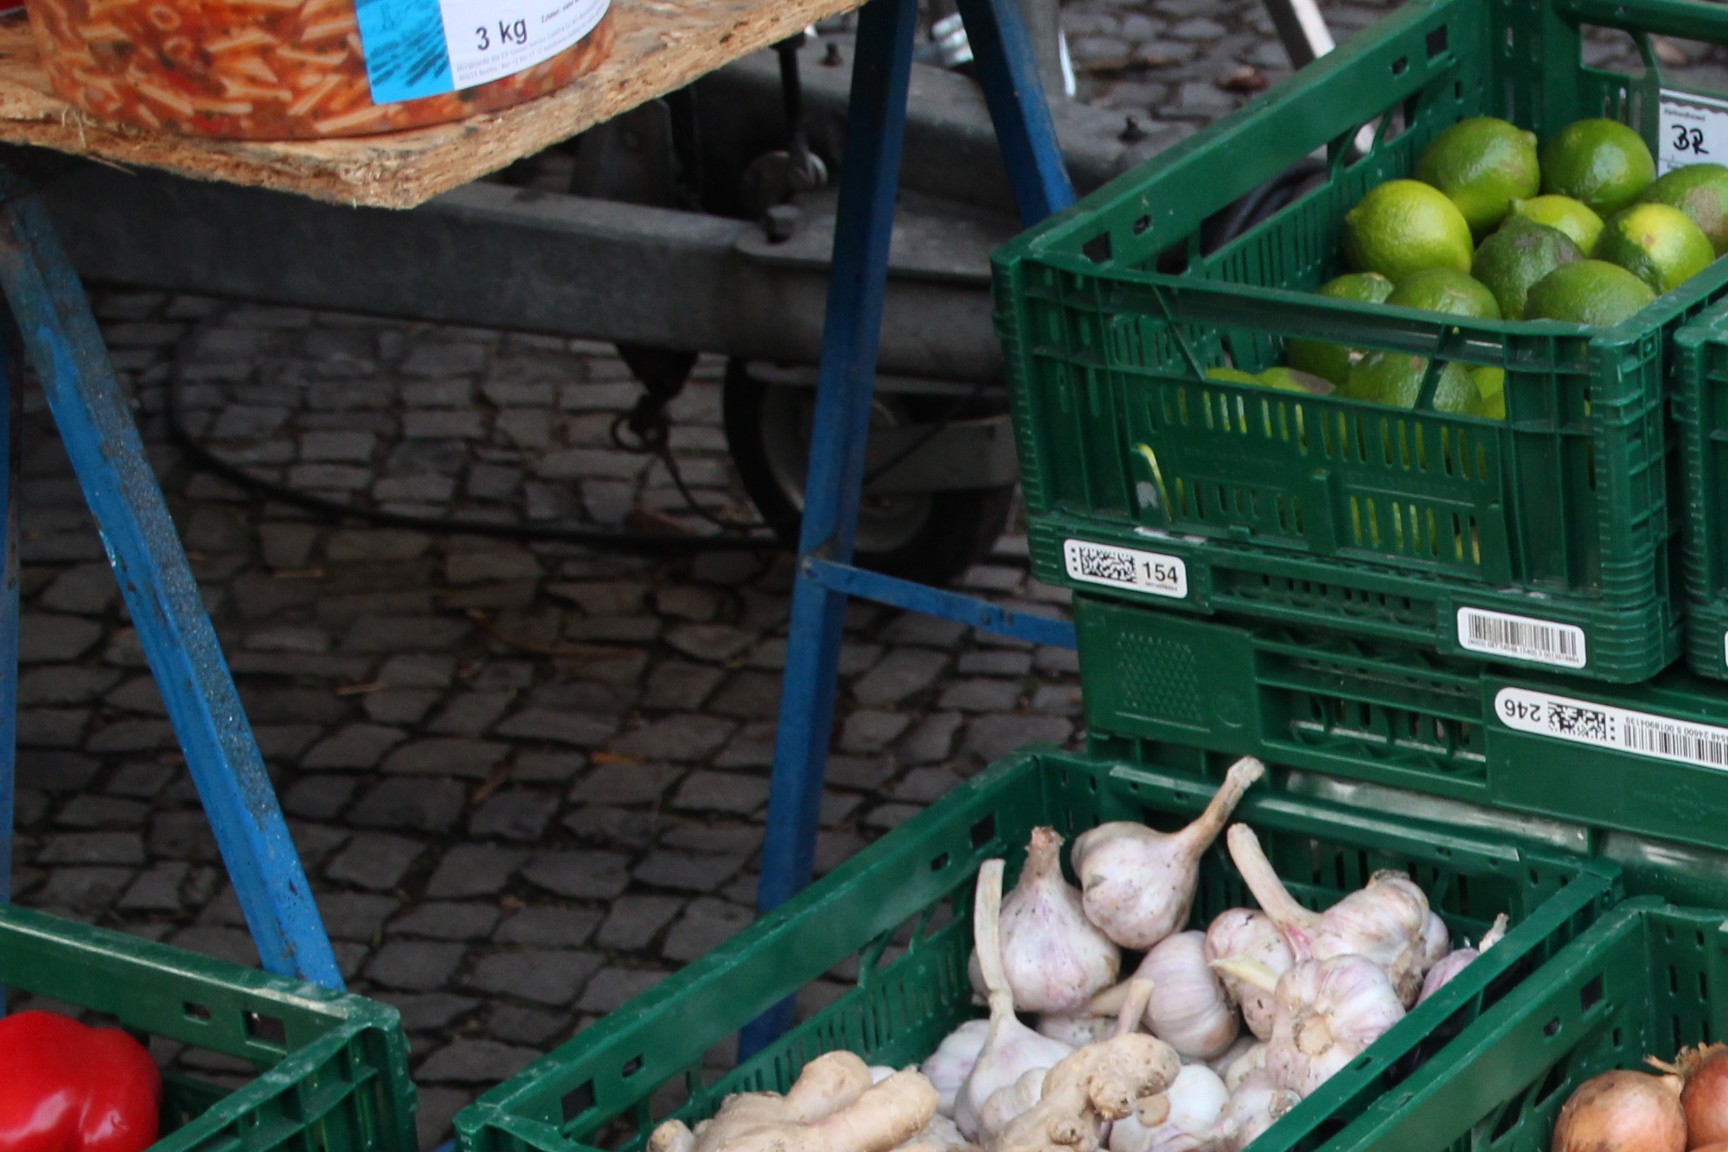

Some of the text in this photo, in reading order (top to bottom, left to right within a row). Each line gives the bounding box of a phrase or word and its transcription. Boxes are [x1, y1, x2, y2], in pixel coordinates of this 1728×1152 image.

[475, 17, 528, 51] 3 kg
[1142, 560, 1179, 584] 154
[1504, 698, 1542, 722] 246
